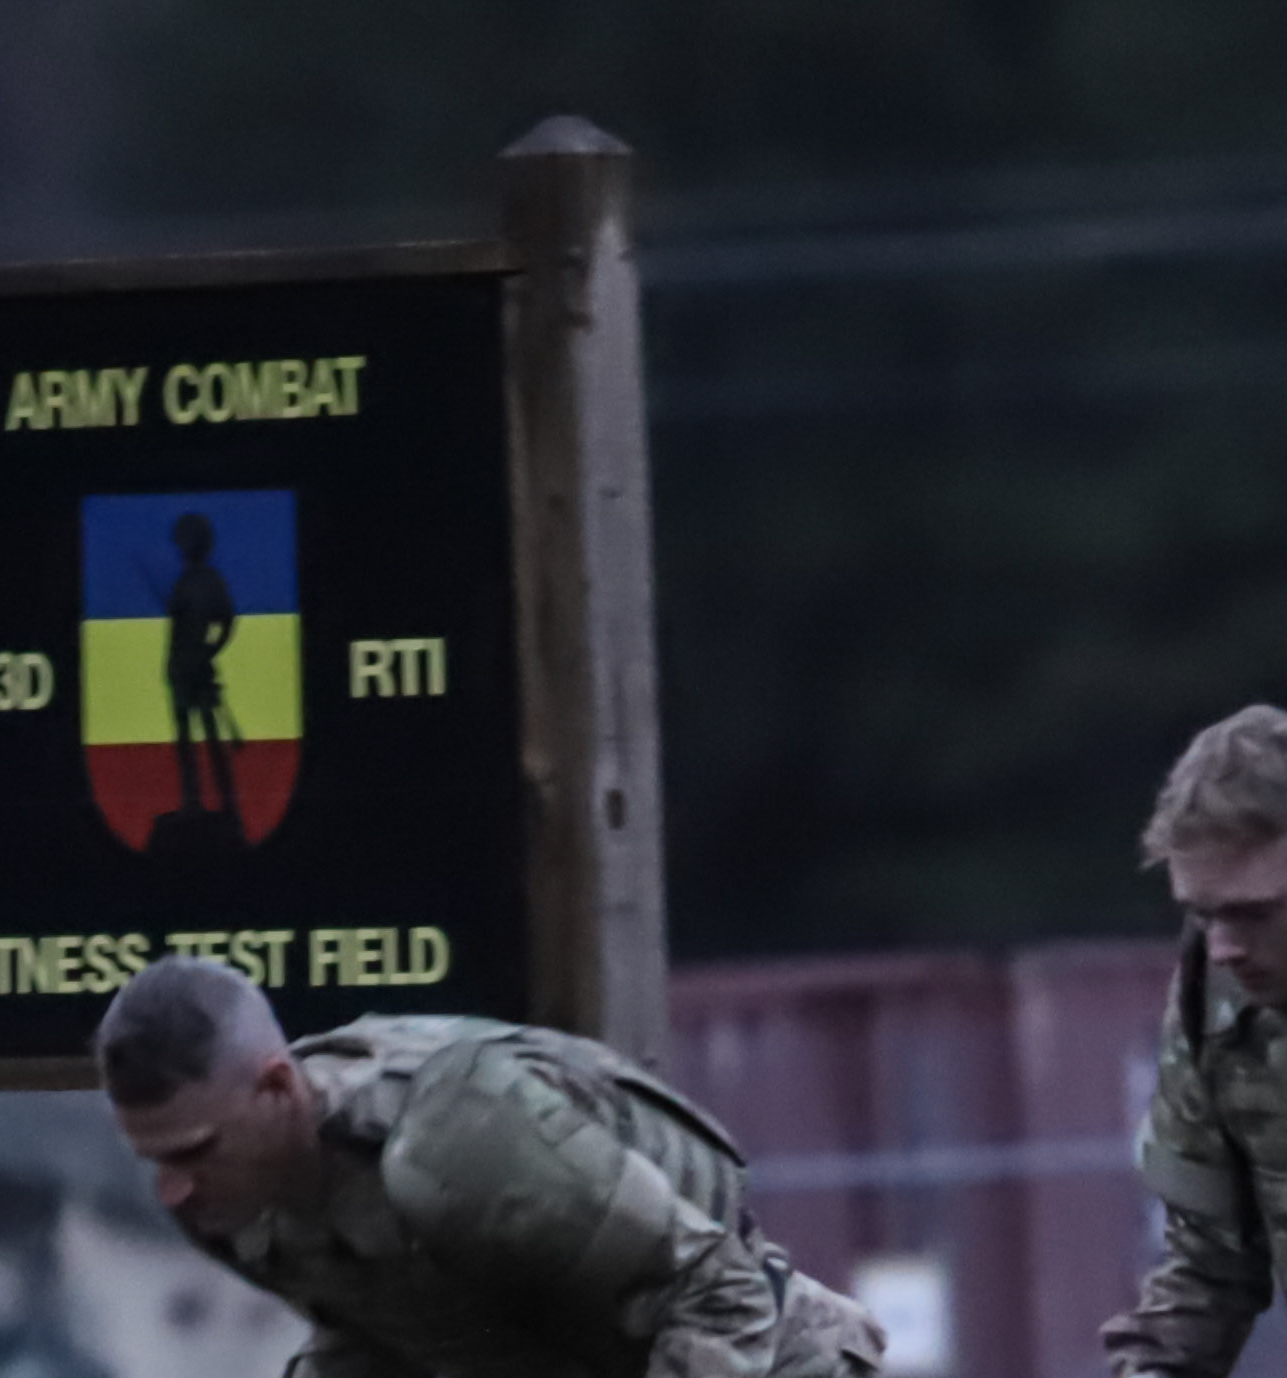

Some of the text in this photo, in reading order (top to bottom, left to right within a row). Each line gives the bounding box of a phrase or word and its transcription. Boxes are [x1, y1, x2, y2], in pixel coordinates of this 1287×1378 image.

[6, 357, 365, 430] ARMY COMBAT
[351, 638, 445, 697] RTI
[310, 927, 449, 986] FIELD
